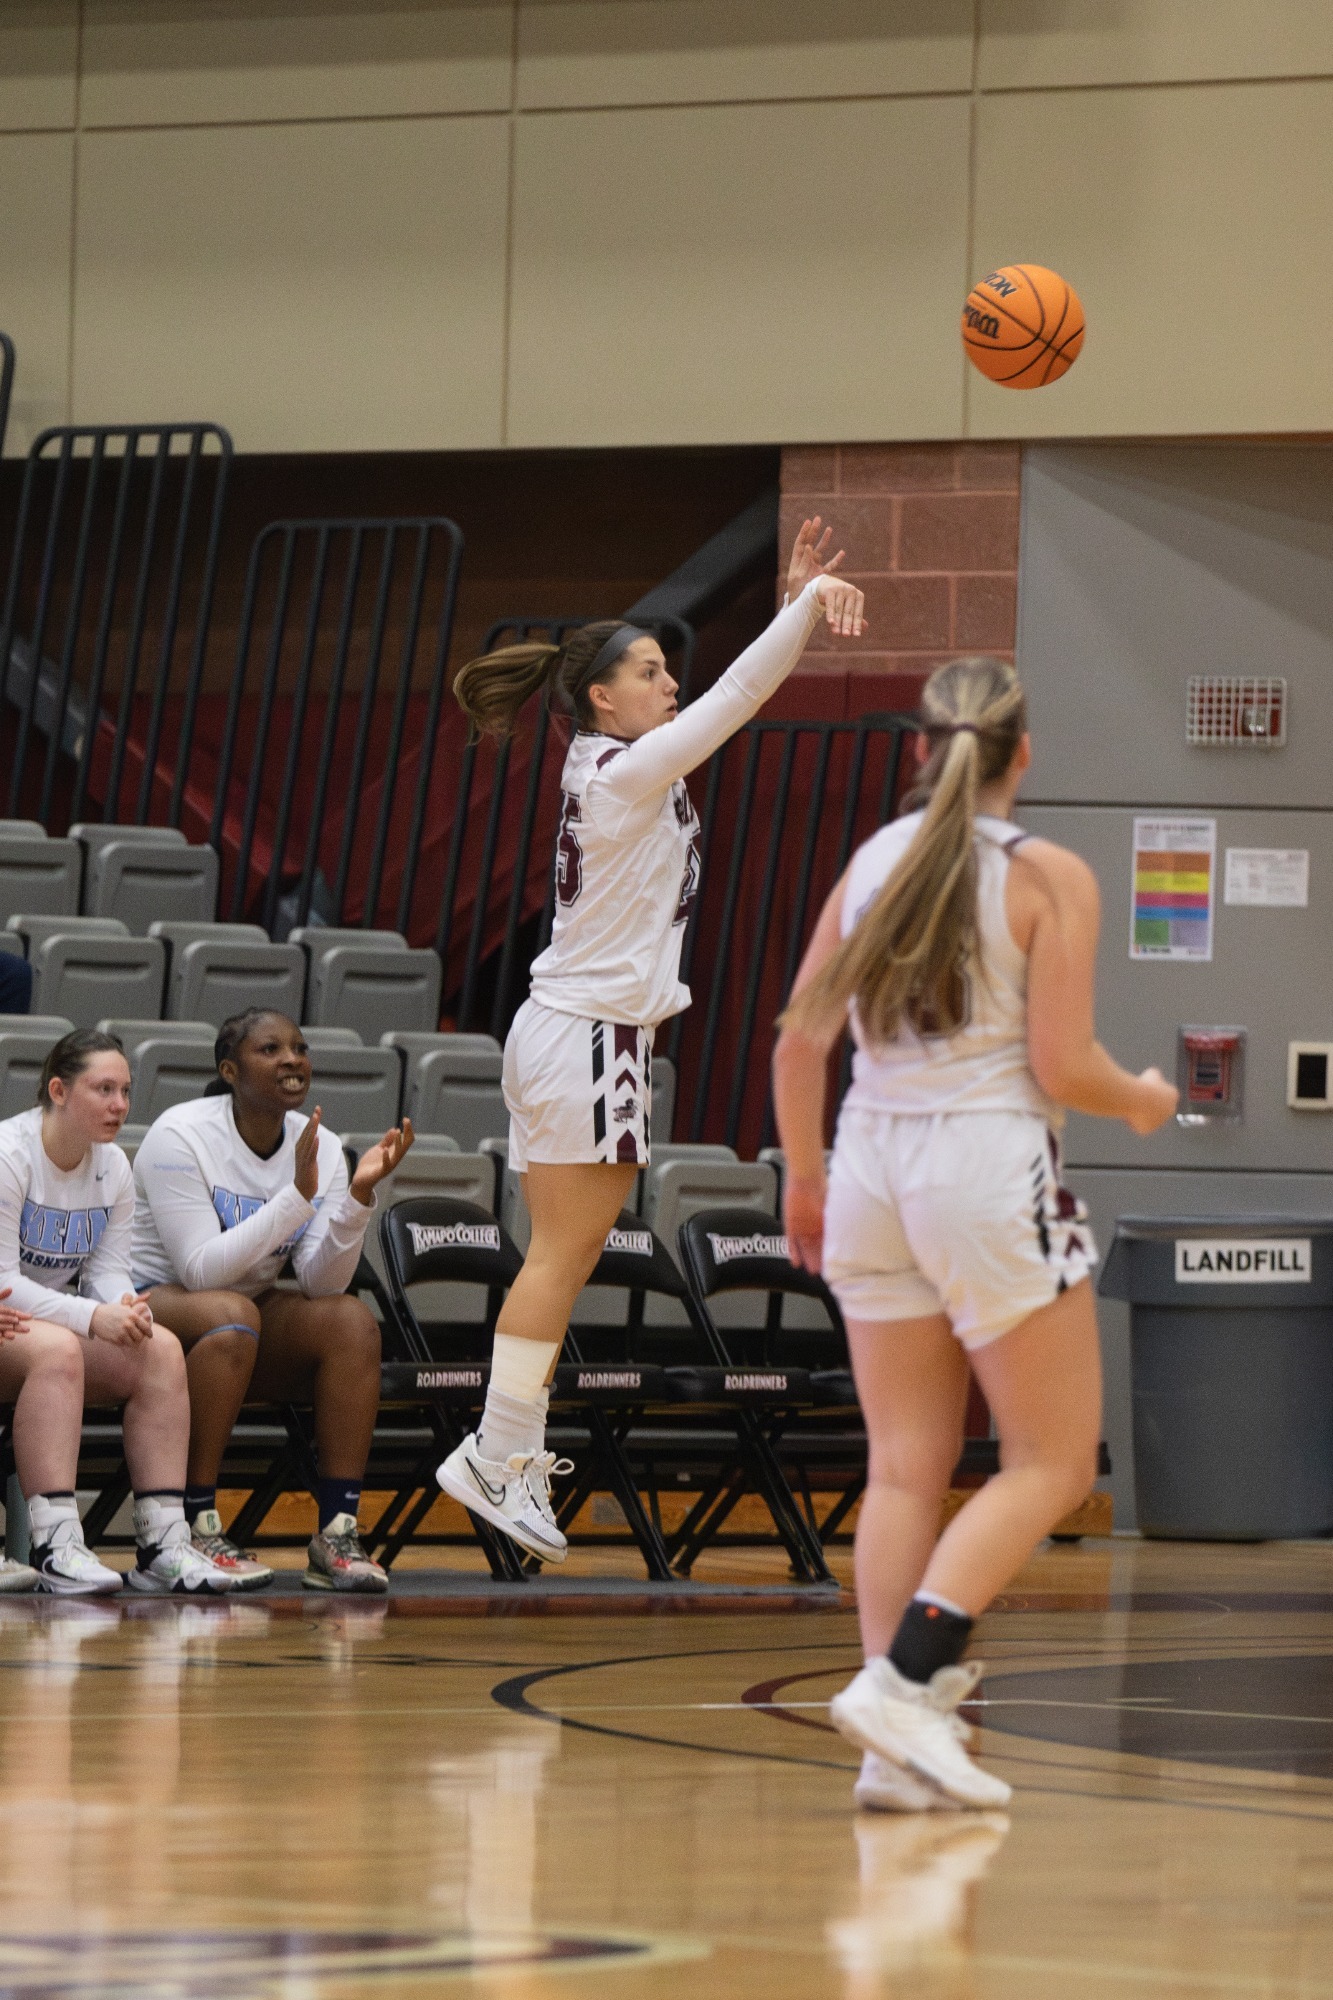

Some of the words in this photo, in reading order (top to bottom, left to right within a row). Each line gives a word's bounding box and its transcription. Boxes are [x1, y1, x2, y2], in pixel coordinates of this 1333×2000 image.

[406, 1222, 455, 1256] RAMAPO
[455, 1222, 500, 1251] COLLEGE
[753, 1232, 790, 1259] COLLEG
[1182, 1249, 1304, 1271] LANDFILL
[416, 1371, 482, 1388] ROADRUNNERS
